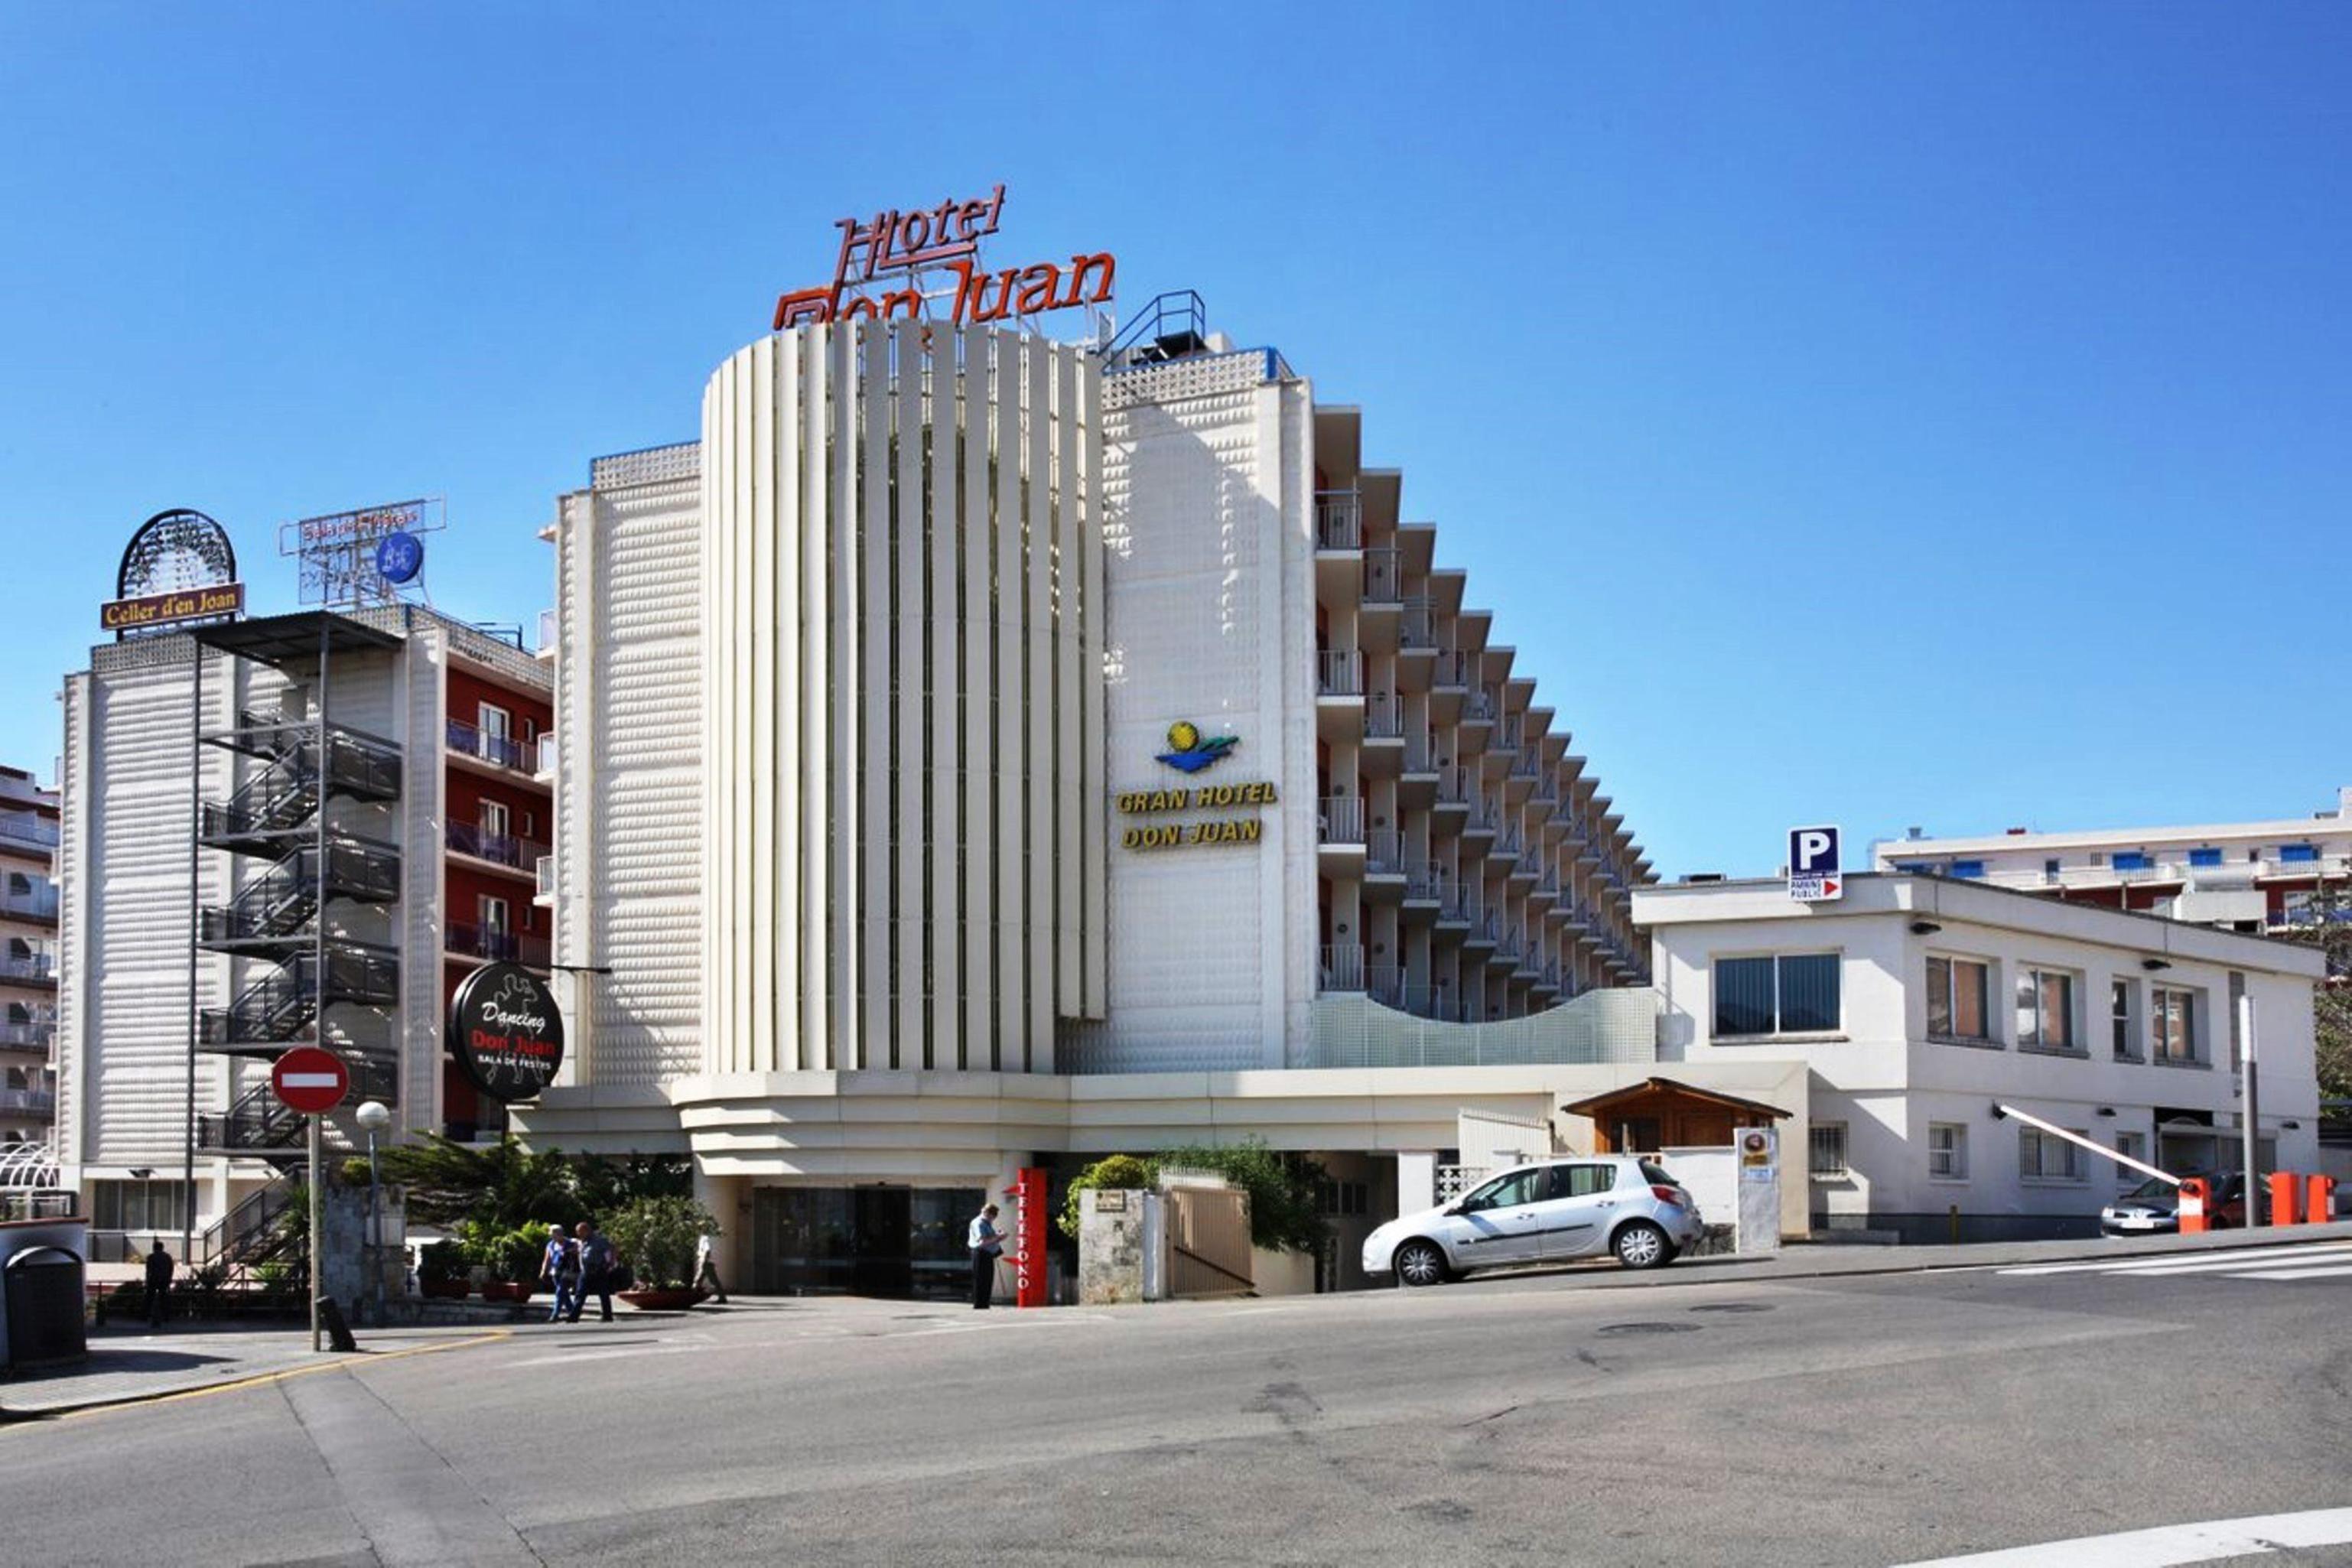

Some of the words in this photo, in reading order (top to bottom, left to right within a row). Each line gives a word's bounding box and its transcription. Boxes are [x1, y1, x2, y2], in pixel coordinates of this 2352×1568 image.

[834, 184, 1005, 281] Hotel
[945, 252, 1115, 324] Juan
[106, 603, 156, 624] Celler
[200, 592, 236, 612] Joan
[1117, 789, 1189, 813] GRAN
[1197, 782, 1277, 807] HOTEL
[1122, 824, 1182, 848] DON
[1189, 818, 1261, 845] JUAN
[1800, 831, 1831, 870] P
[481, 1001, 545, 1034] Dancing
[471, 1030, 509, 1050] Don
[514, 1036, 556, 1056] Juan
[477, 1055, 502, 1065] SALA
[504, 1057, 516, 1066] DE
